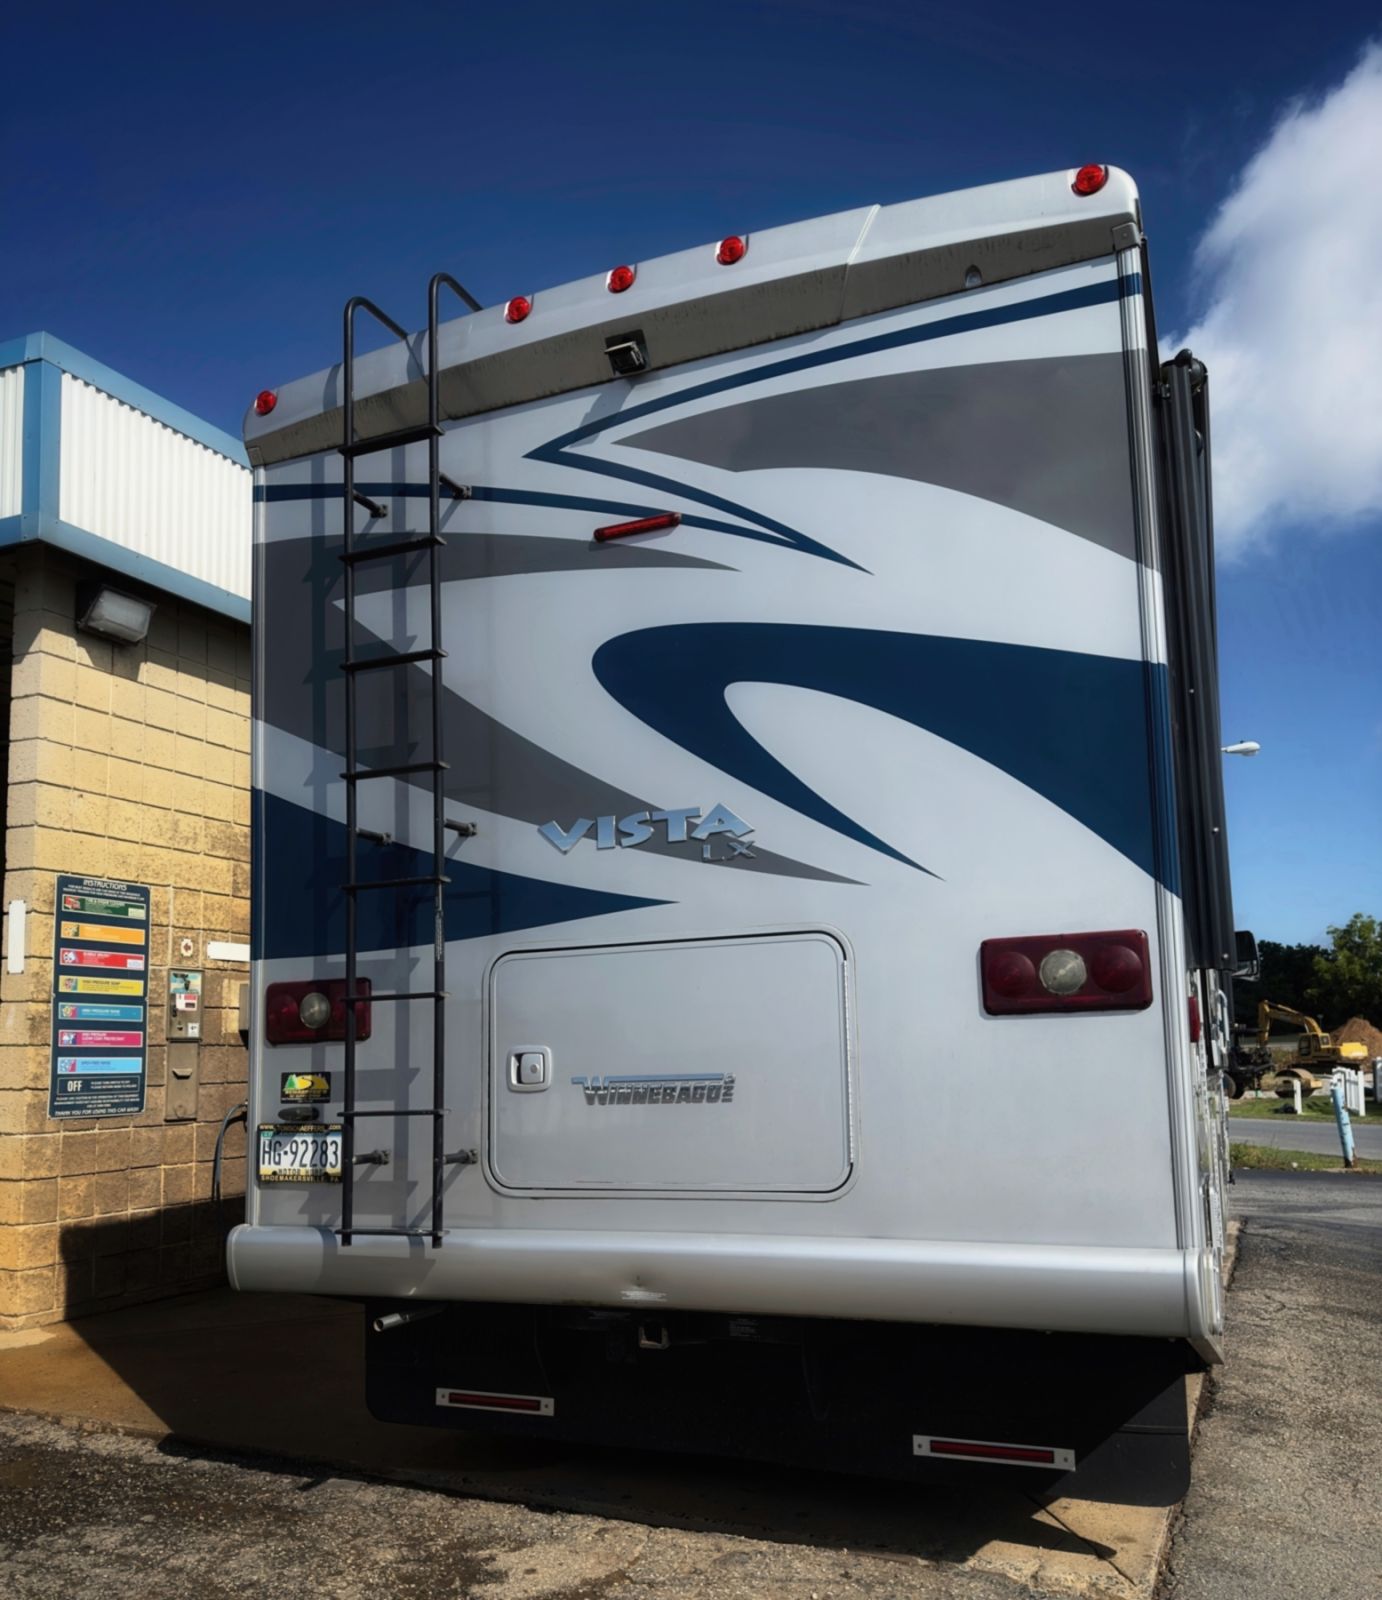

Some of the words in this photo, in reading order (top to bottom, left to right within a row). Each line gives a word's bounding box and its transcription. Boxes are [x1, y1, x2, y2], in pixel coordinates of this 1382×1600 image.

[537, 802, 755, 855] VISTA
[83, 879, 127, 891] INSTRUCTIONS
[67, 1080, 83, 1092] OFF
[571, 1073, 724, 1106] WINNEBAGO
